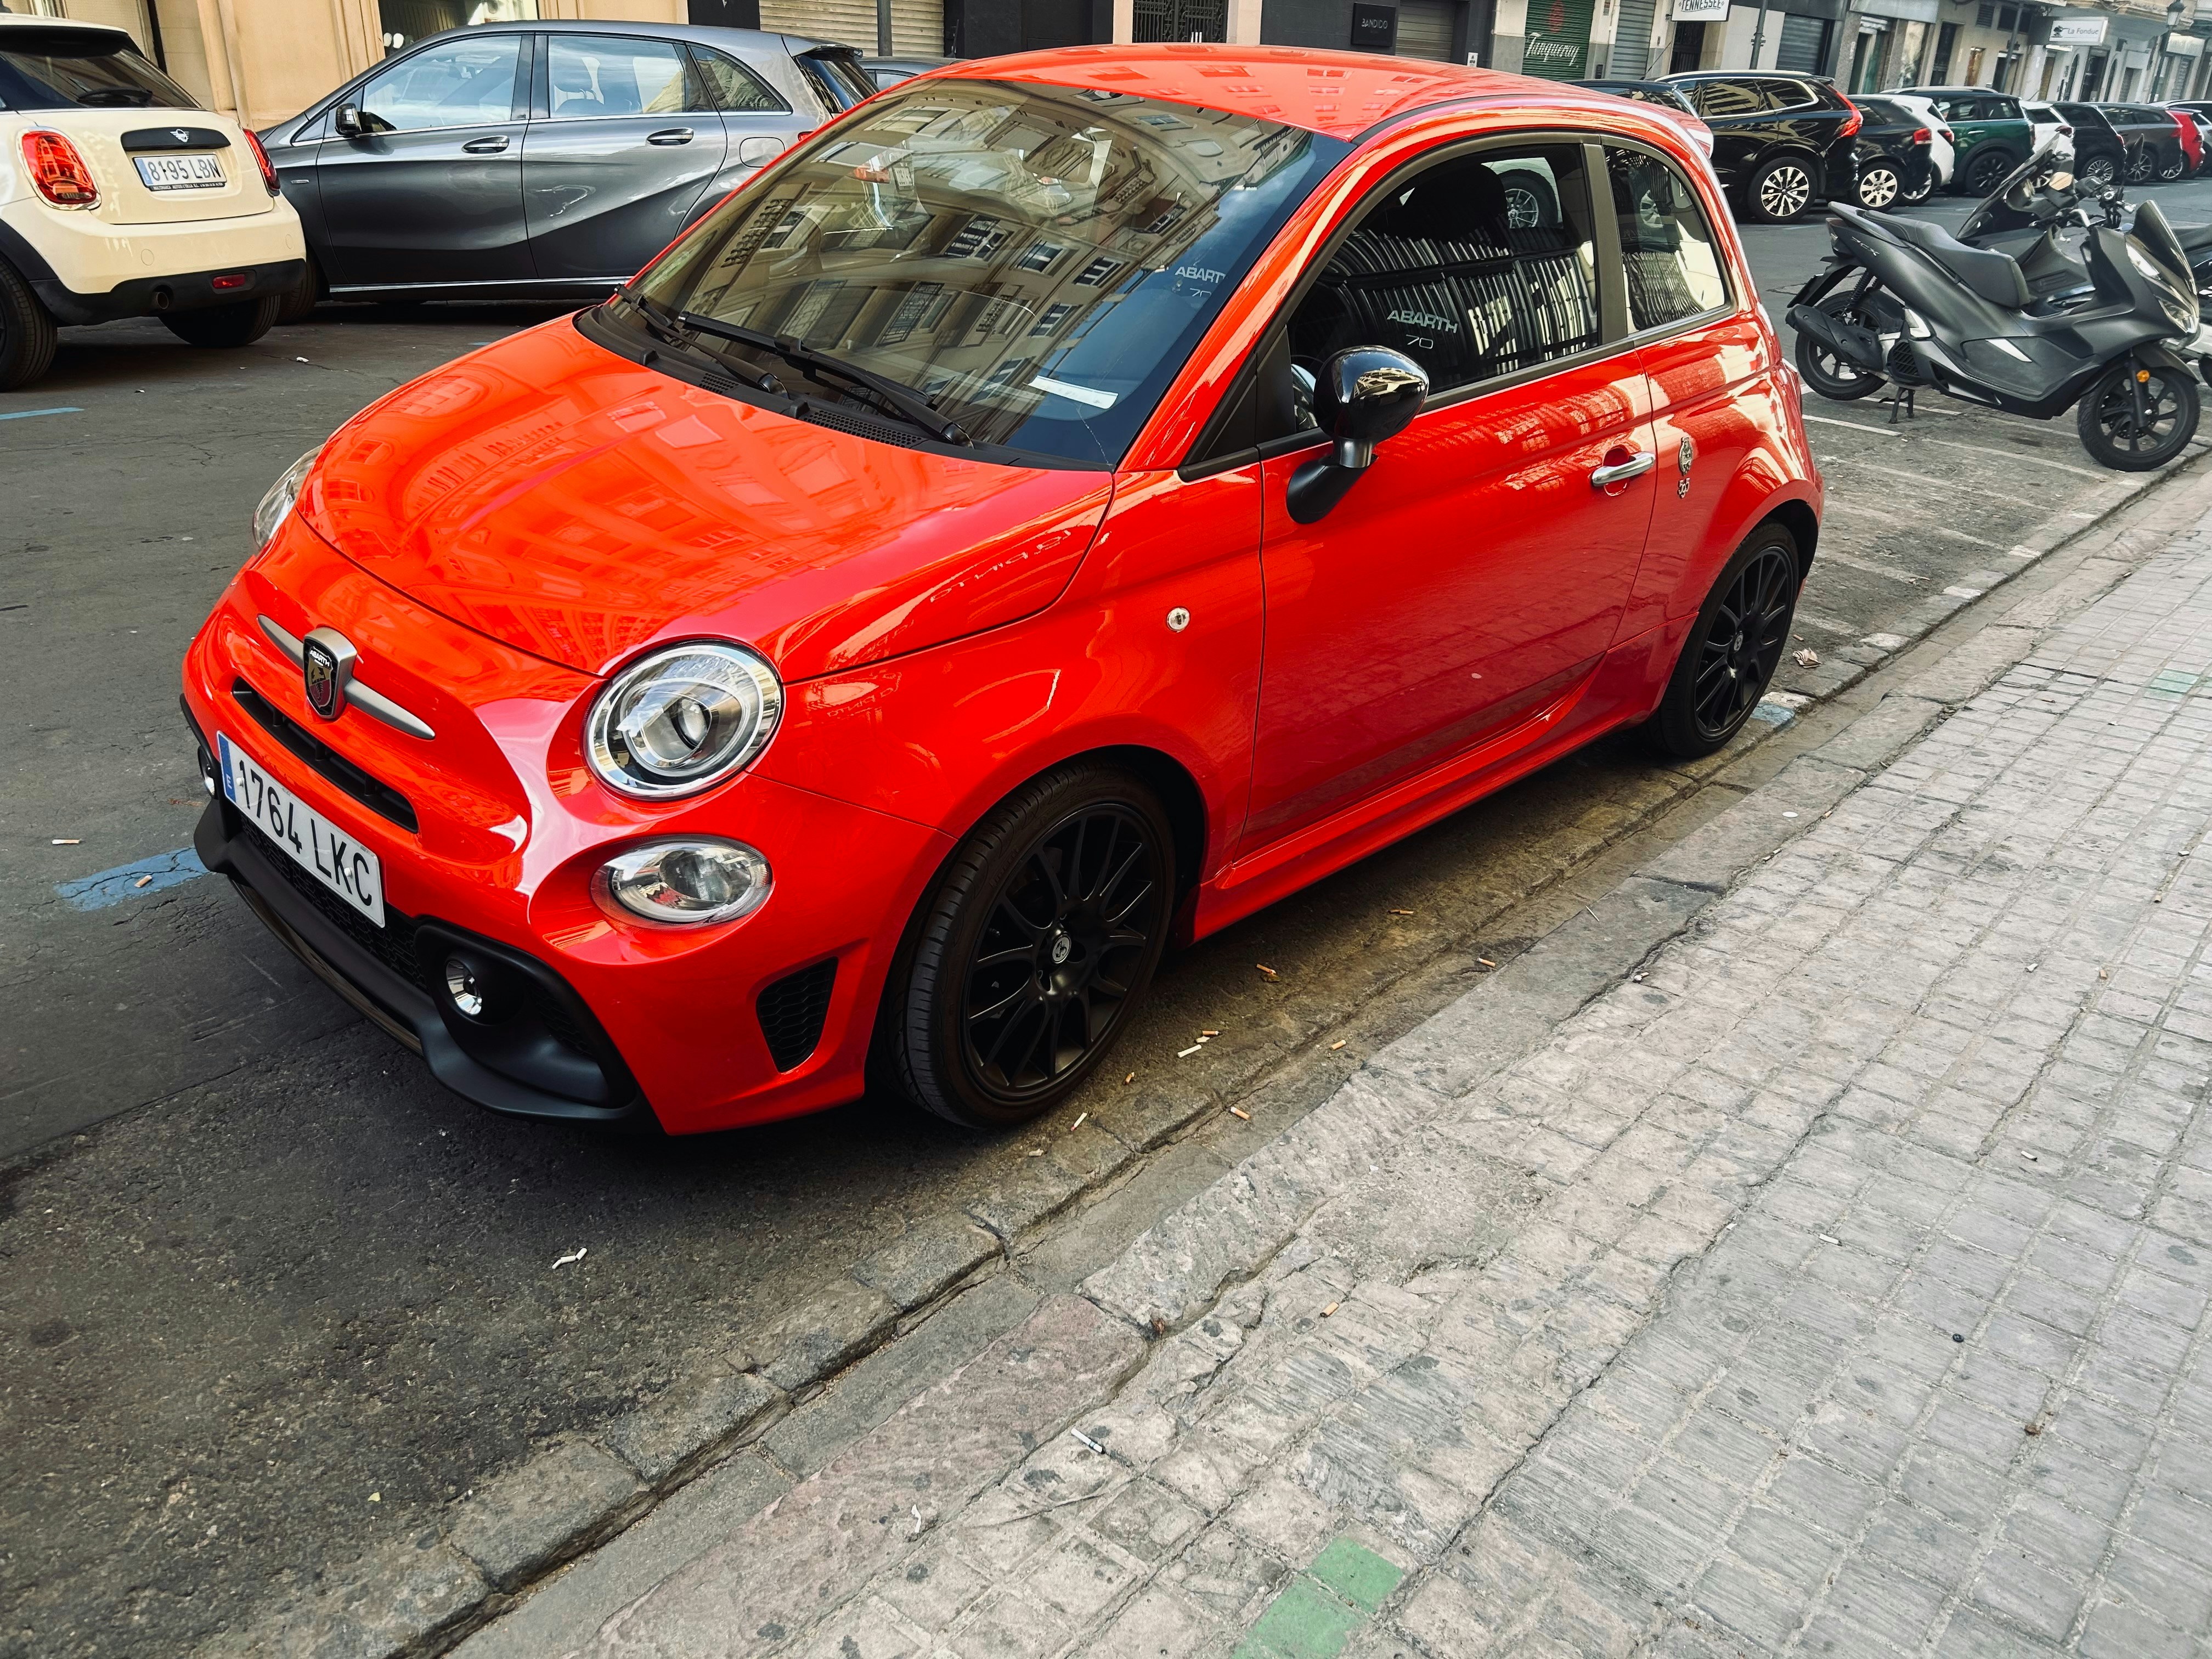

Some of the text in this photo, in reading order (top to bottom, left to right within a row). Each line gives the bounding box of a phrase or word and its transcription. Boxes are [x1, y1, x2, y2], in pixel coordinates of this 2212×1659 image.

[1681, 0, 1721, 10] TENNESSEE
[147, 158, 221, 181] 8195 LBN
[1175, 266, 1226, 283] ABART
[1386, 310, 1458, 334] ABARTH
[1406, 334, 1434, 349] 70
[309, 650, 330, 667] ABARTH
[239, 760, 372, 906] 1764 LKC
